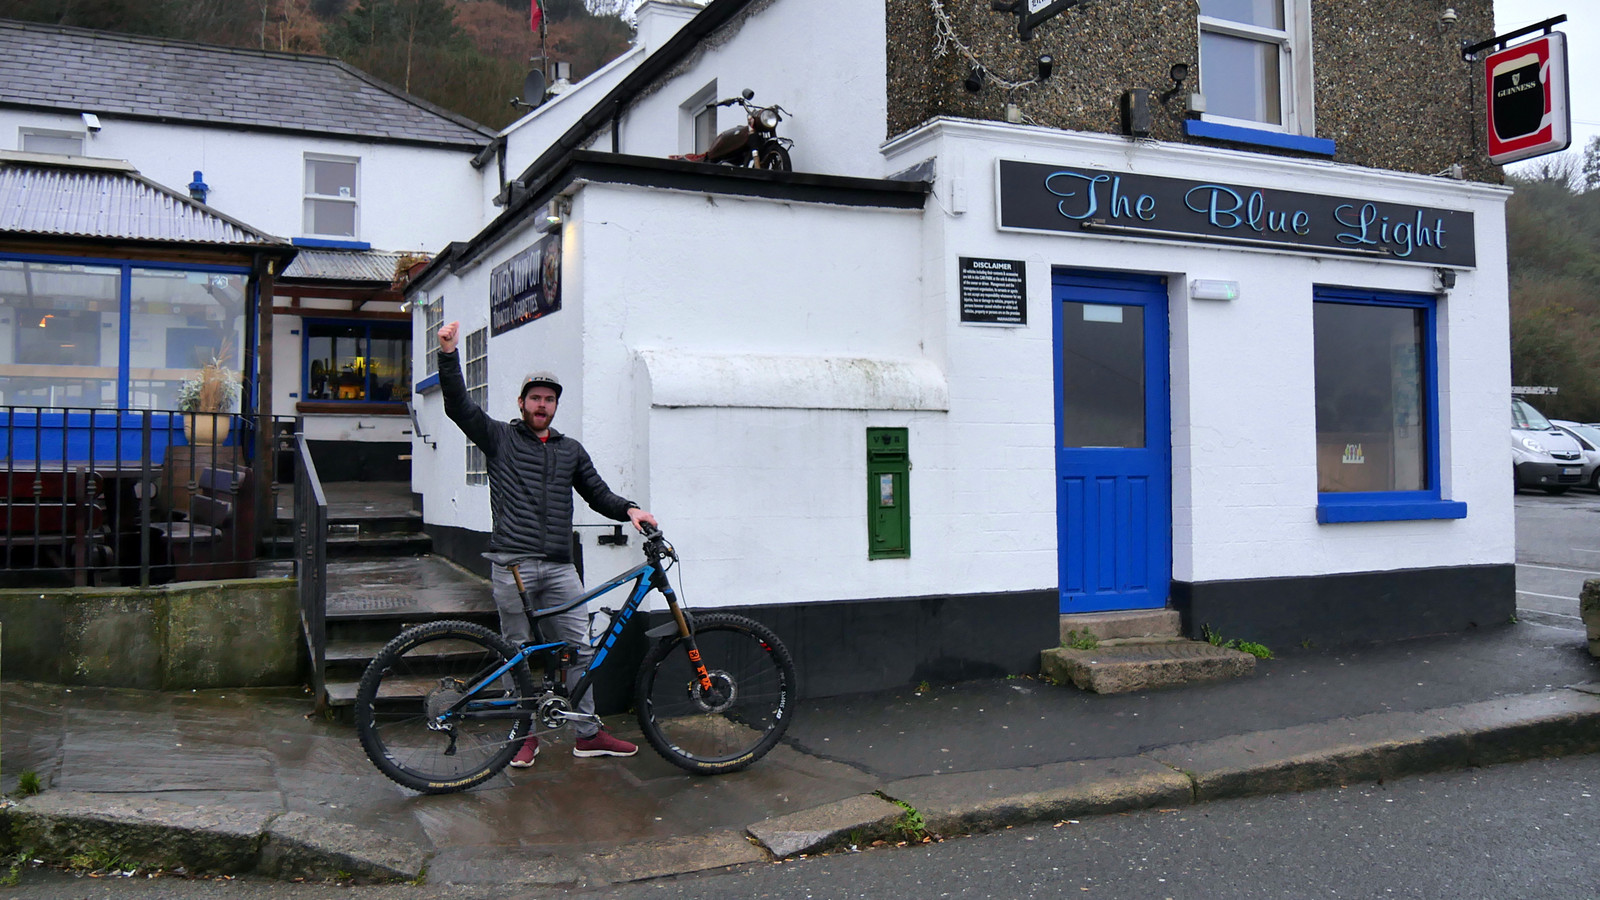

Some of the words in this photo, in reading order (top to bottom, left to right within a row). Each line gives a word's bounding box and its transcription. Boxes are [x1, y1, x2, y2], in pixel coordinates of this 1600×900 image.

[1497, 81, 1536, 98] GUINNESS
[1045, 170, 1156, 221] The
[1185, 184, 1310, 236] Blue
[1333, 202, 1447, 257] Light
[973, 261, 1012, 270] DISCLAIMER
